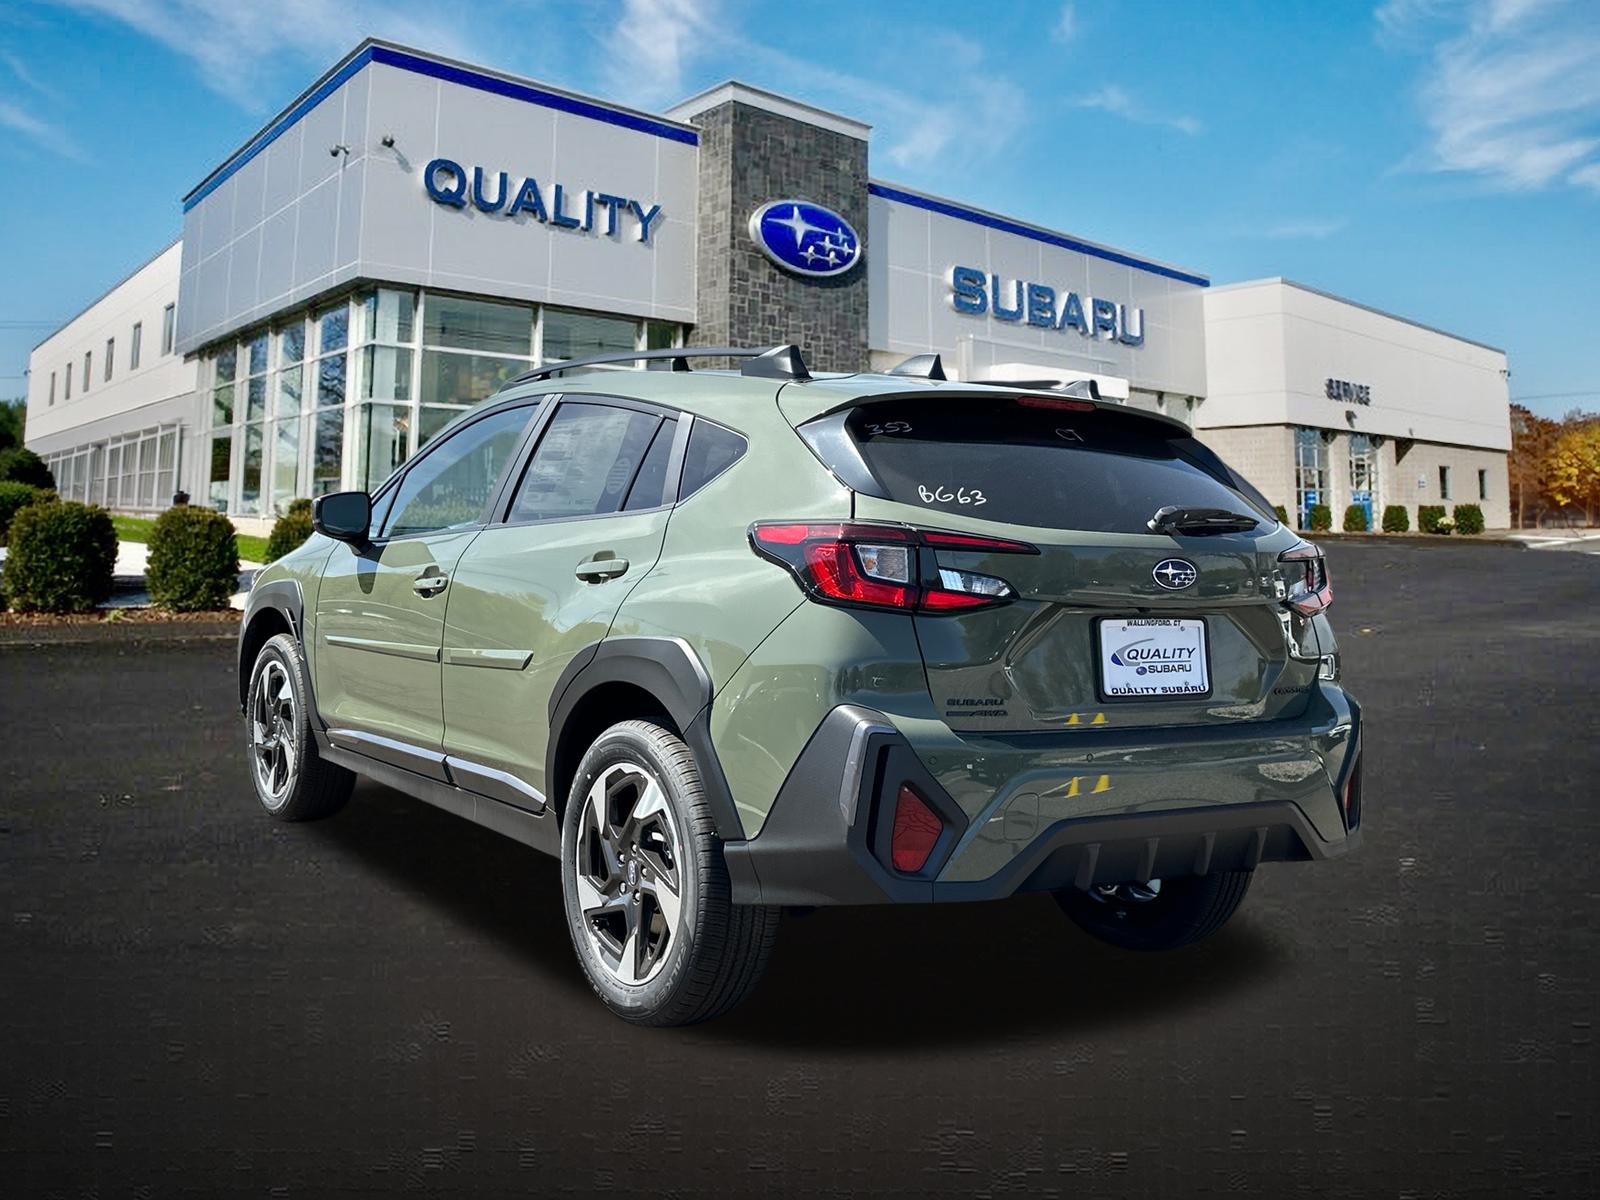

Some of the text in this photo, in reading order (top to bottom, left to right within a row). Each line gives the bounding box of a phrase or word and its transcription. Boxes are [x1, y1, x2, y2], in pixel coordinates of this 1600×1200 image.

[424, 158, 662, 243] QUALITY
[951, 265, 1145, 346] SUBARU
[1325, 378, 1371, 406] SERVICE
[1127, 648, 1196, 661] QUALITY
[1148, 664, 1191, 673] SUBARU
[1111, 685, 1206, 695] QUALITY SUBARU
